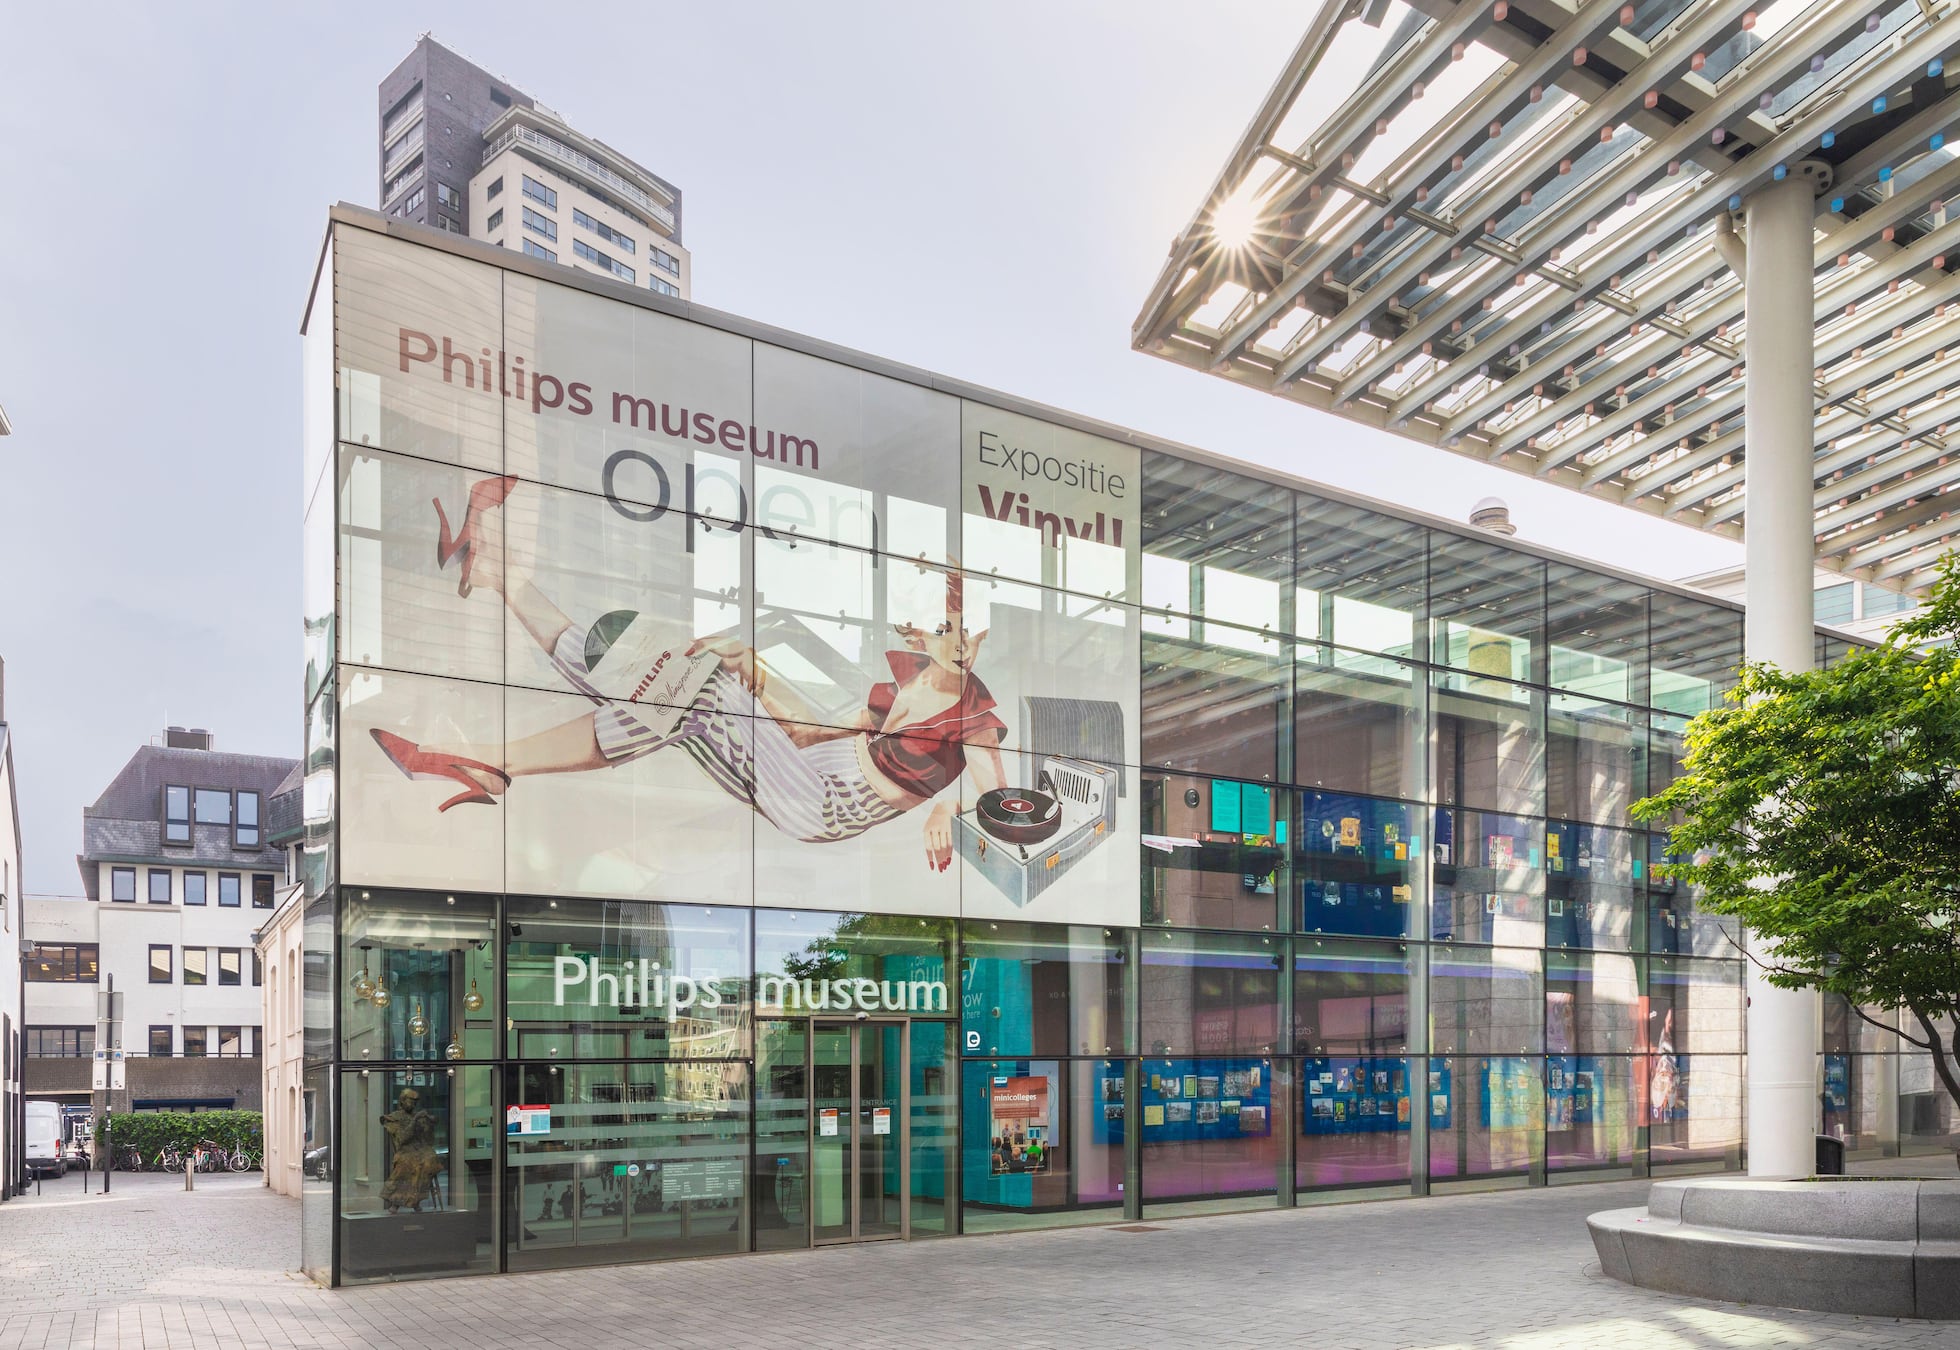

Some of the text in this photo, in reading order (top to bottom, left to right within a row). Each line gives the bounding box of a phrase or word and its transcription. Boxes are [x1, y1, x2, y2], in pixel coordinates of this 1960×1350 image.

[398, 327, 820, 470] Philips museum
[978, 430, 1125, 499] Expositie
[602, 449, 878, 568] open
[629, 650, 672, 704] PHILIPS
[554, 956, 948, 1023] Philips museum
[993, 1093, 1037, 1102] minicolleges
